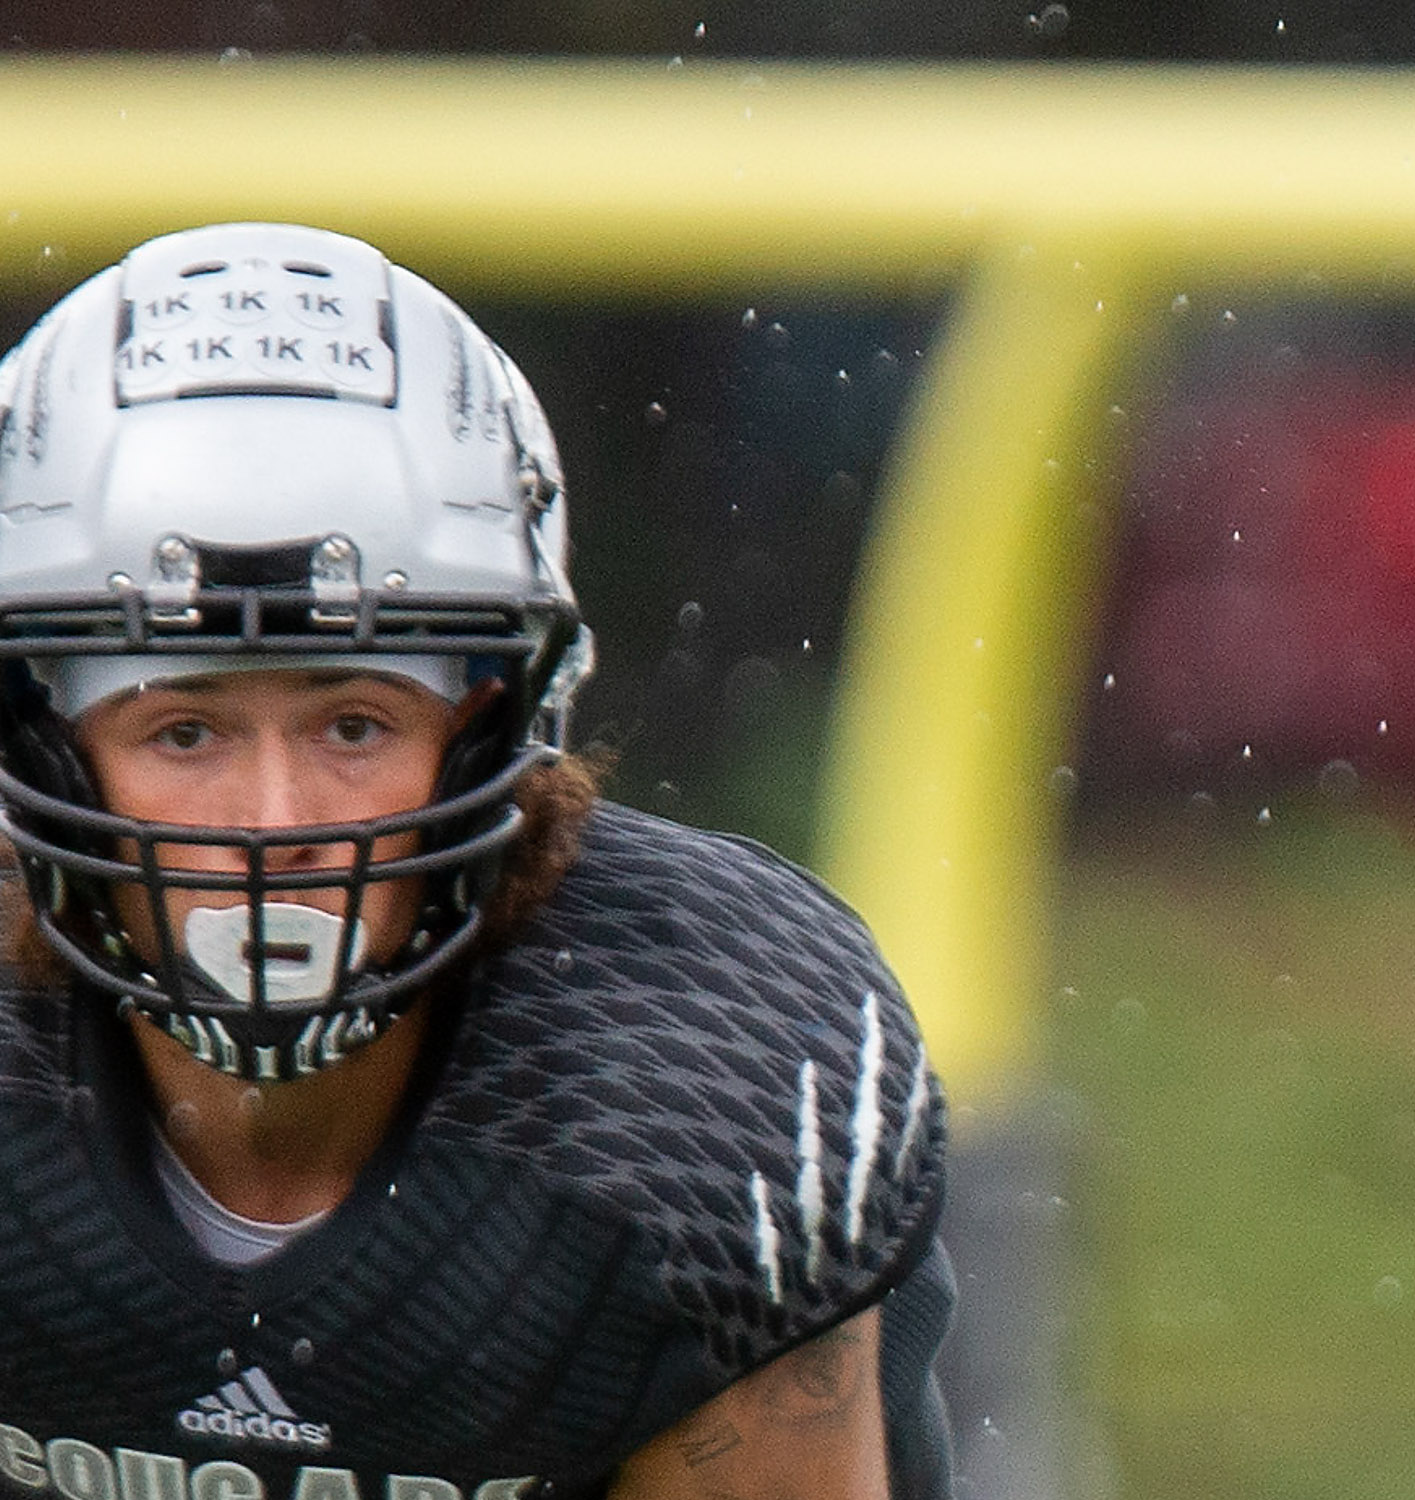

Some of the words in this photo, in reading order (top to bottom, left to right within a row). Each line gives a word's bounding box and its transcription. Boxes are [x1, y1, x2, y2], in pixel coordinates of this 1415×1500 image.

[144, 292, 191, 318] 1K
[219, 290, 267, 311] 1K
[295, 292, 343, 317] 1K
[118, 340, 165, 371] 1K
[186, 336, 233, 361] 1K
[254, 336, 303, 362] 1K
[325, 340, 374, 372] 1K
[178, 1407, 331, 1445] adidas
